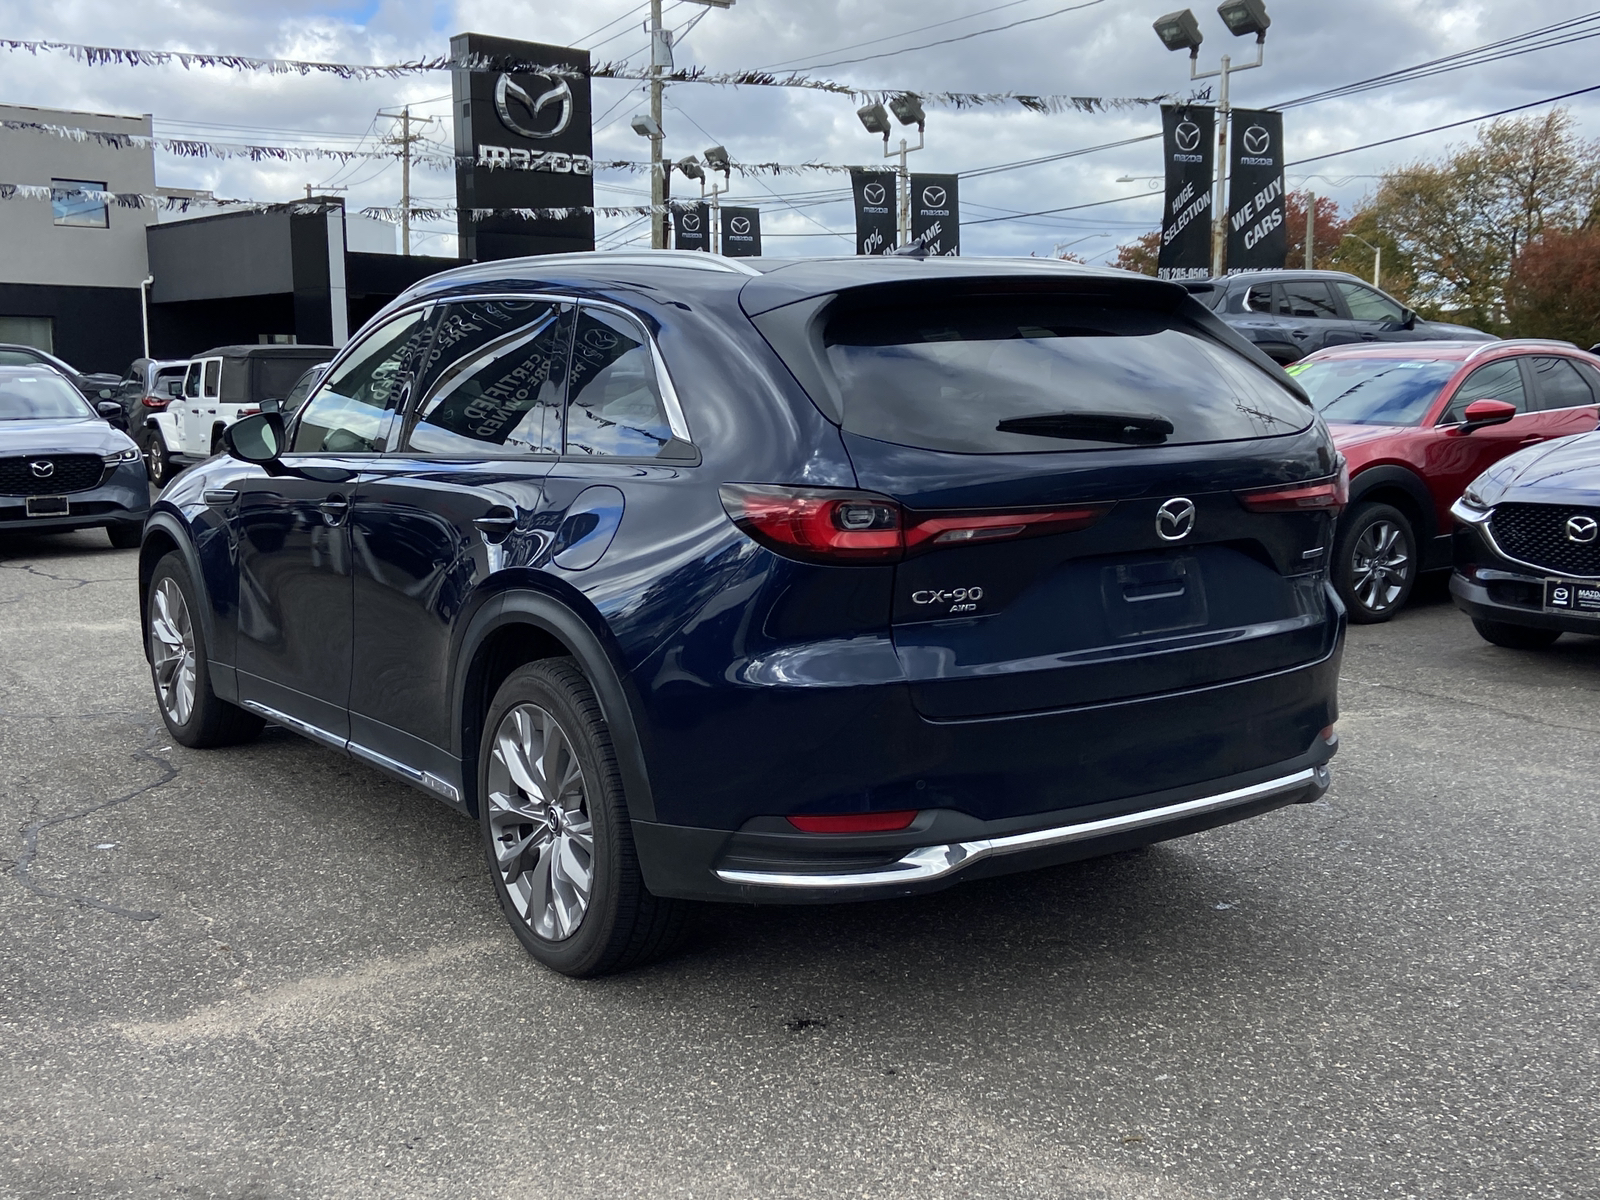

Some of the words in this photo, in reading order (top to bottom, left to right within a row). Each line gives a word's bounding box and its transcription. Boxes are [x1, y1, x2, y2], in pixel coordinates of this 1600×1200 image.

[1171, 181, 1196, 215] HUGE
[1231, 200, 1254, 232] WE
[1254, 175, 1284, 212] BUY
[1164, 191, 1211, 246] SELECTION
[1244, 207, 1283, 250] CARS
[864, 228, 883, 256] 0%
[911, 586, 983, 604] CX-90
[949, 604, 977, 613] AWD
